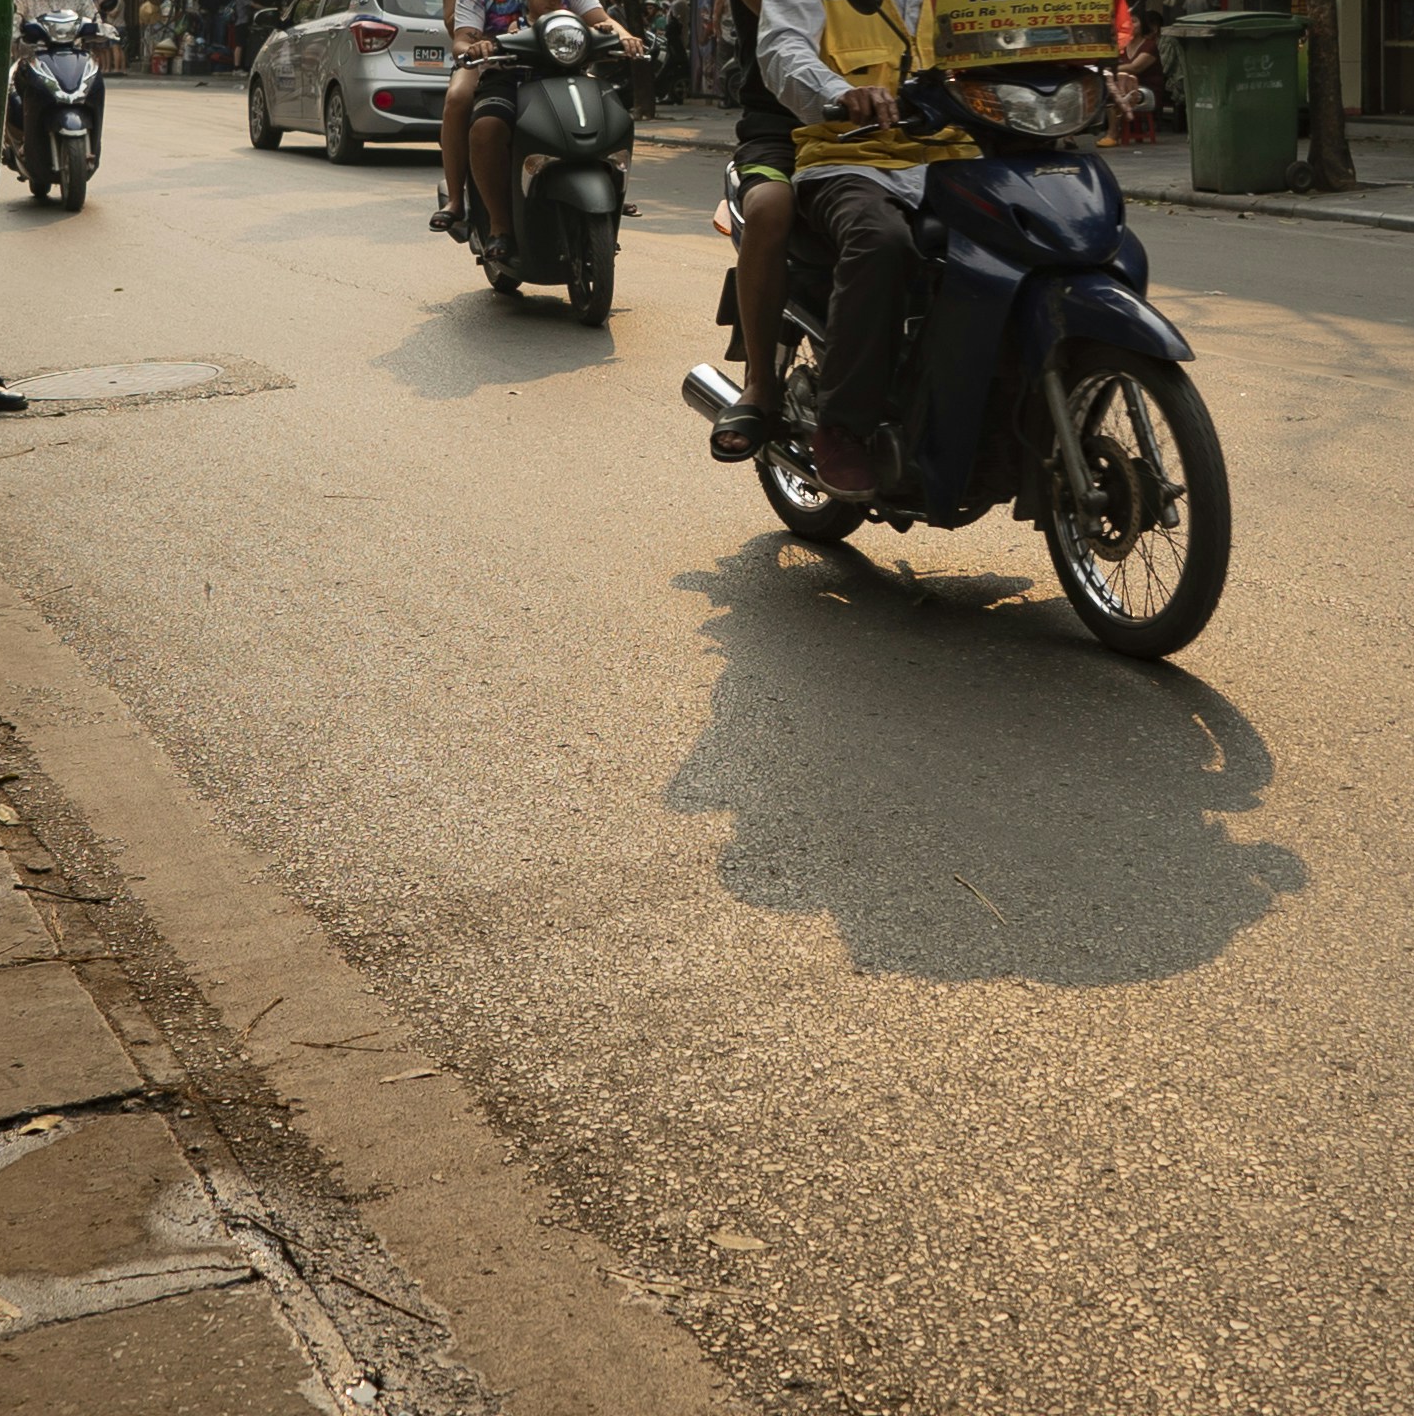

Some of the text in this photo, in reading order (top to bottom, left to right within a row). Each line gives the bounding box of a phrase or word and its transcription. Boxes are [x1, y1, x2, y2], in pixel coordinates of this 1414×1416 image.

[1010, 2, 1039, 14] Tính
[1027, 15, 1049, 26] 37
[1055, 14, 1075, 24] 52
[1078, 13, 1096, 24] 52
[415, 48, 444, 60] EMDI
